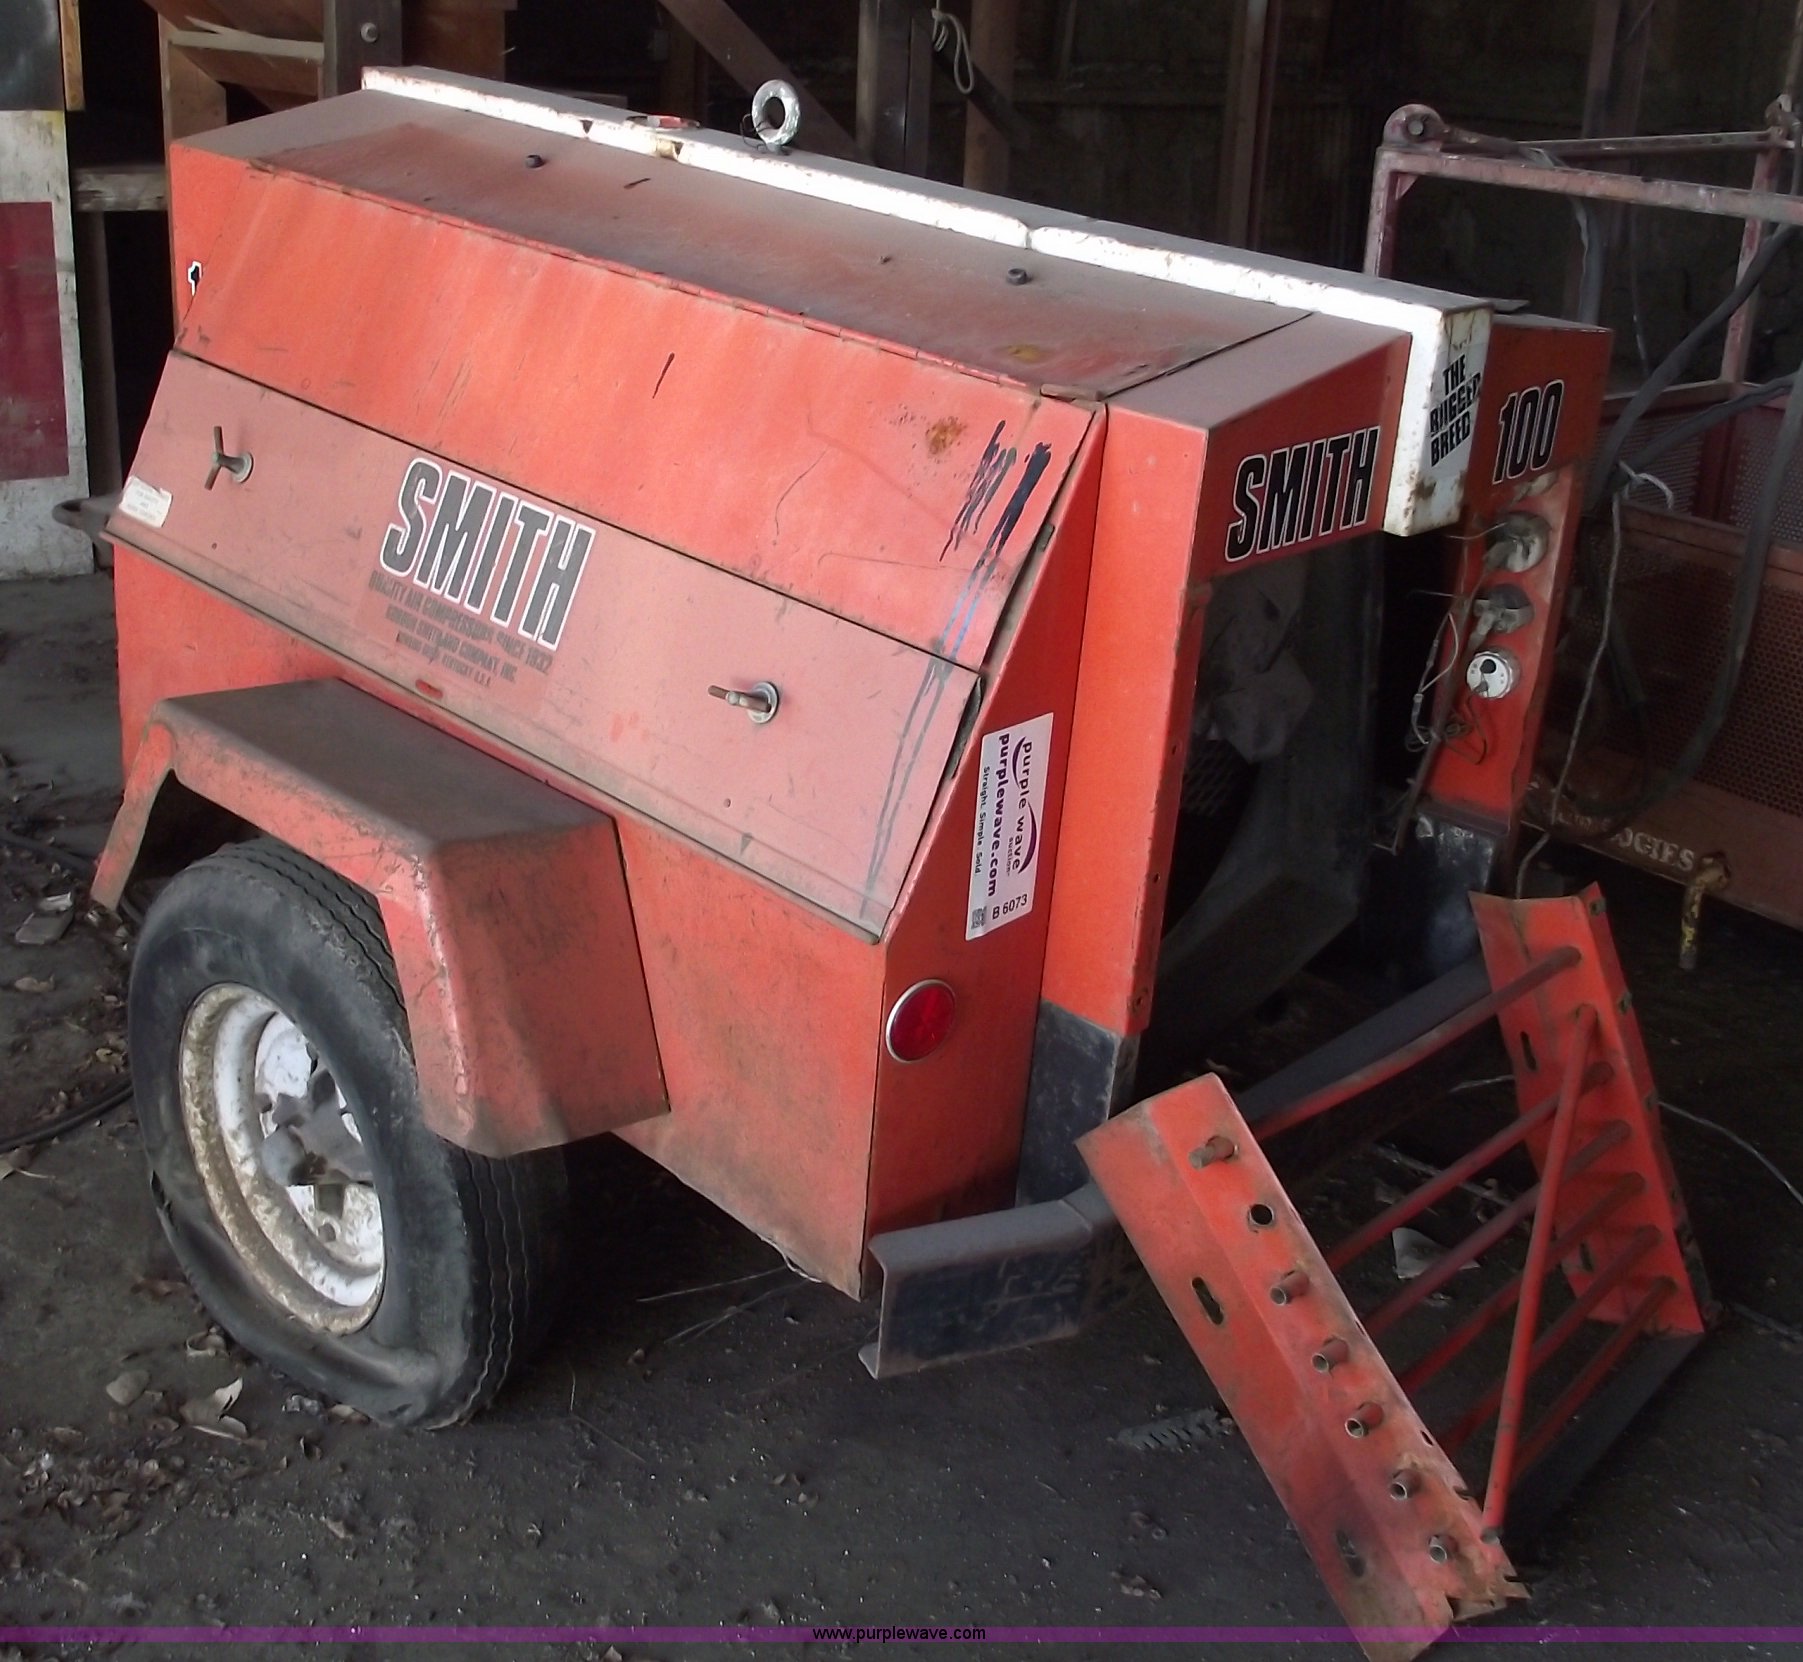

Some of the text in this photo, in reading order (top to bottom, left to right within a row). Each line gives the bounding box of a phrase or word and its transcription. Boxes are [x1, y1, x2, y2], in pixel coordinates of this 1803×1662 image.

[1443, 354, 1465, 395] THE
[1492, 379, 1564, 485] 100
[1225, 426, 1381, 562] SMITH
[1431, 410, 1470, 467] BREED
[380, 457, 596, 651] SMITH
[987, 733, 1010, 898] purplewave.com
[1012, 741, 1033, 871] purple wave
[992, 893, 1028, 920] B 6073
